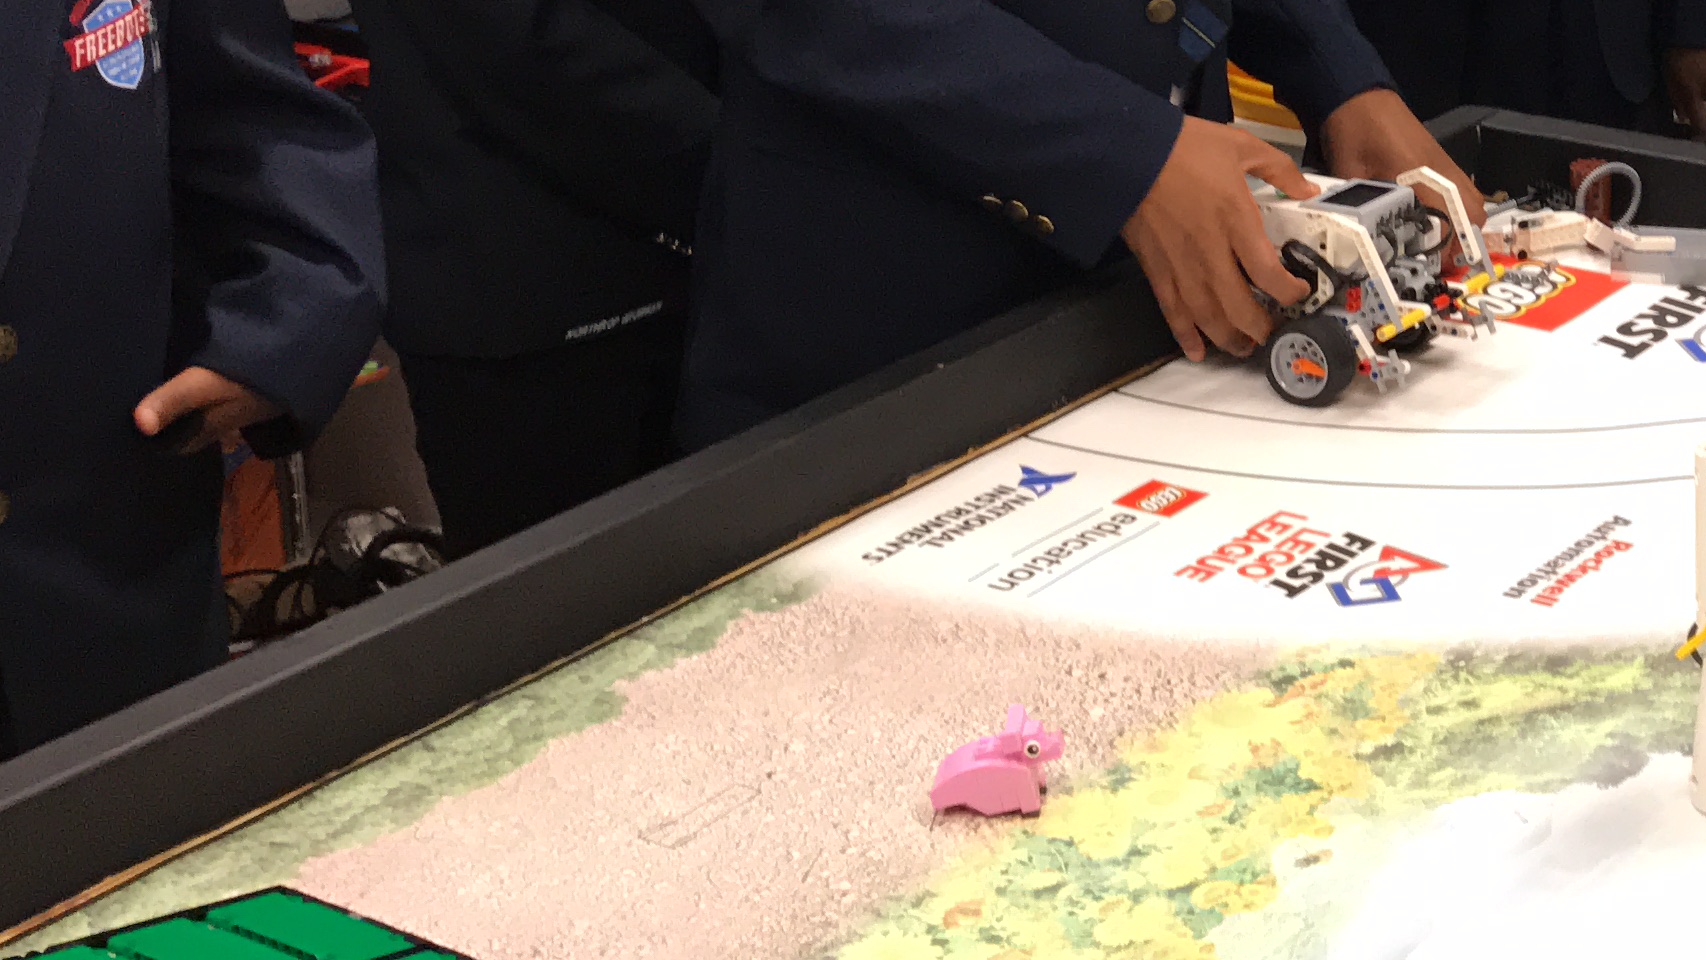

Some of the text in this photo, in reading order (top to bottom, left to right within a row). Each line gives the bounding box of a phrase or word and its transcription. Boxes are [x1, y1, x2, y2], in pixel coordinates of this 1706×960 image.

[74, 6, 146, 68] FREEBOTS
[861, 484, 1017, 564] INSTRUMENTS
[918, 493, 1036, 548] NATIONAL
[1138, 486, 1186, 512] LEGO
[988, 512, 1138, 592] education
[1173, 509, 1309, 583] LEAGUE
[1237, 527, 1332, 580] LEGO
[1268, 531, 1376, 599] FIRST
[1502, 515, 1632, 599] Automation
[1530, 539, 1634, 607] Rockwell
